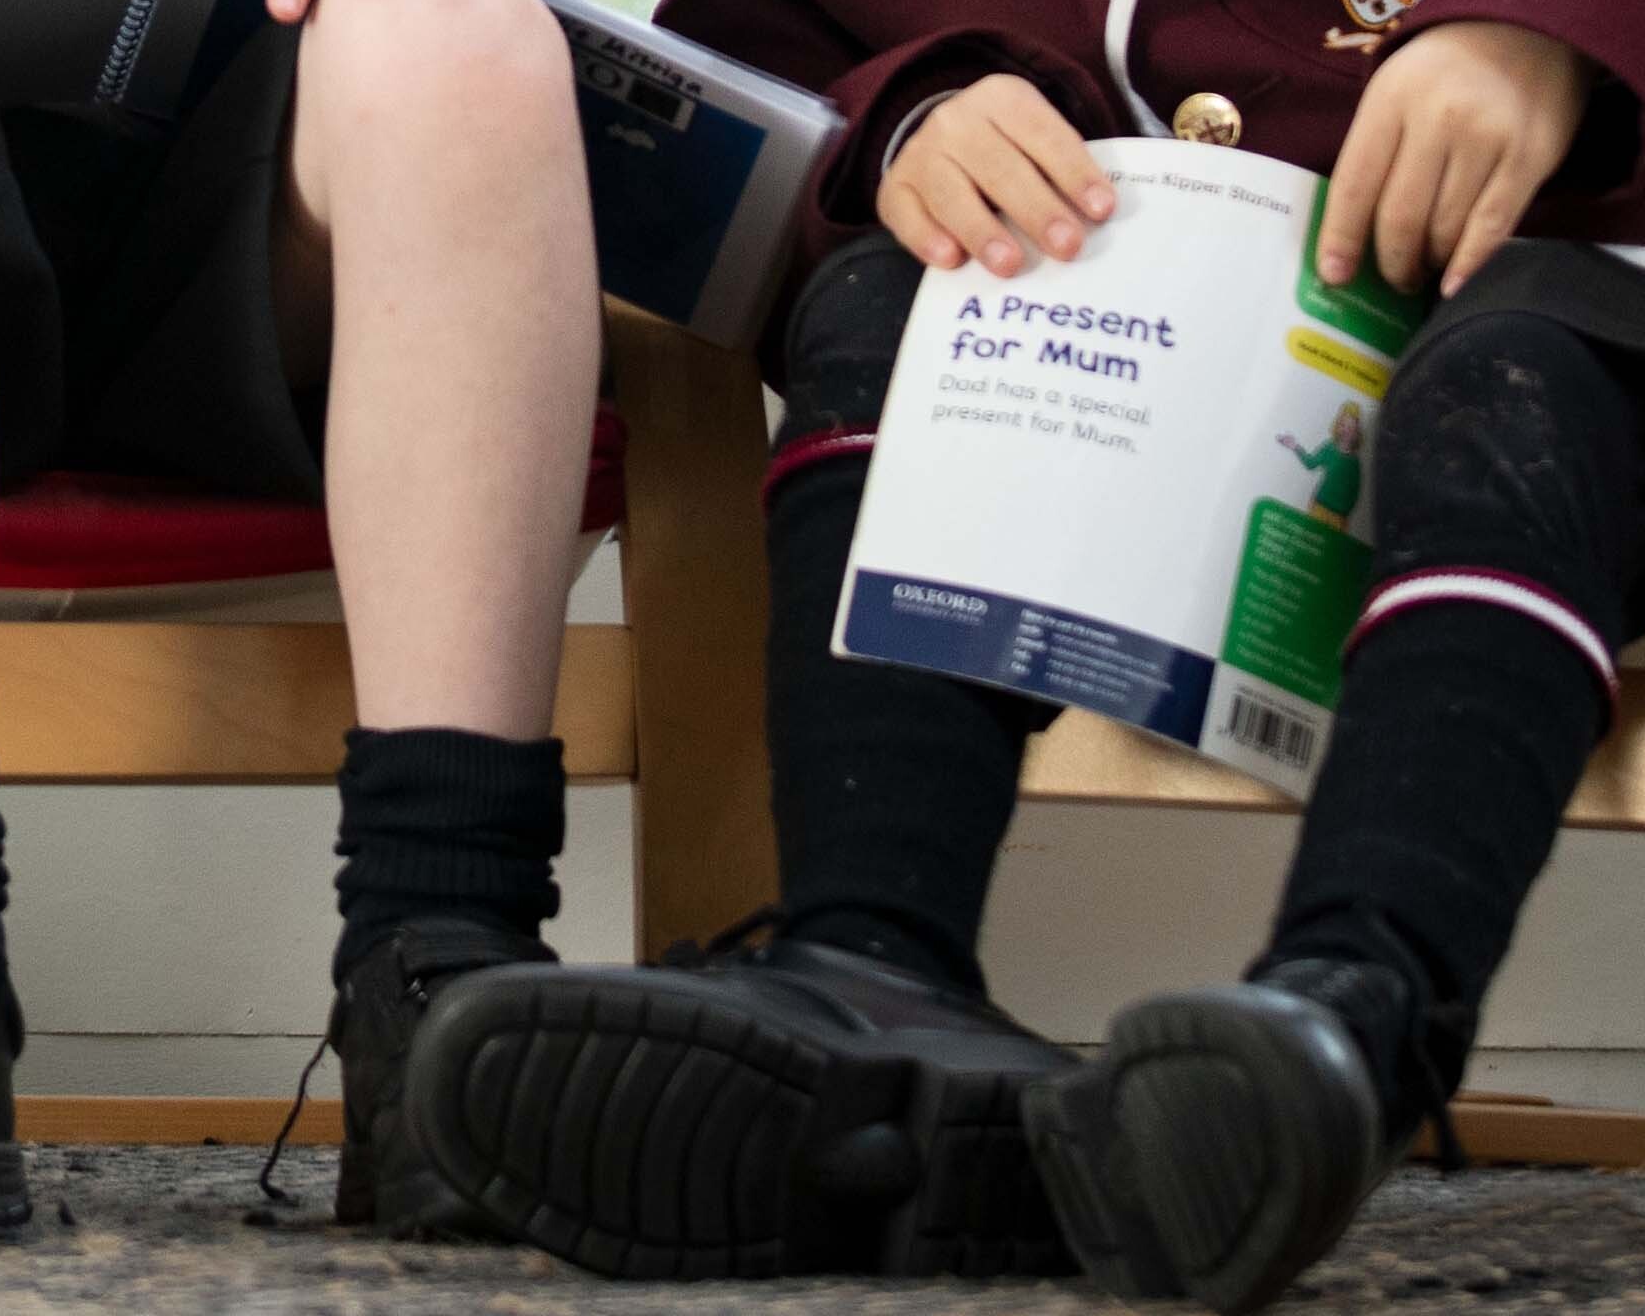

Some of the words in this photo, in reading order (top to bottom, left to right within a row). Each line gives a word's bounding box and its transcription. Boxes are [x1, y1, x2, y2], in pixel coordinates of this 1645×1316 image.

[958, 295, 983, 320] A
[999, 295, 1176, 348] Present
[950, 331, 1022, 361] for
[1037, 339, 1139, 382] Mum
[937, 373, 987, 395] Dad
[994, 376, 1038, 400] has
[1044, 388, 1063, 404] a
[1069, 393, 1152, 427] special
[931, 402, 1023, 429] present
[1029, 410, 1065, 434] for
[1071, 422, 1140, 454] Mum.
[892, 583, 989, 616] OXFORD
